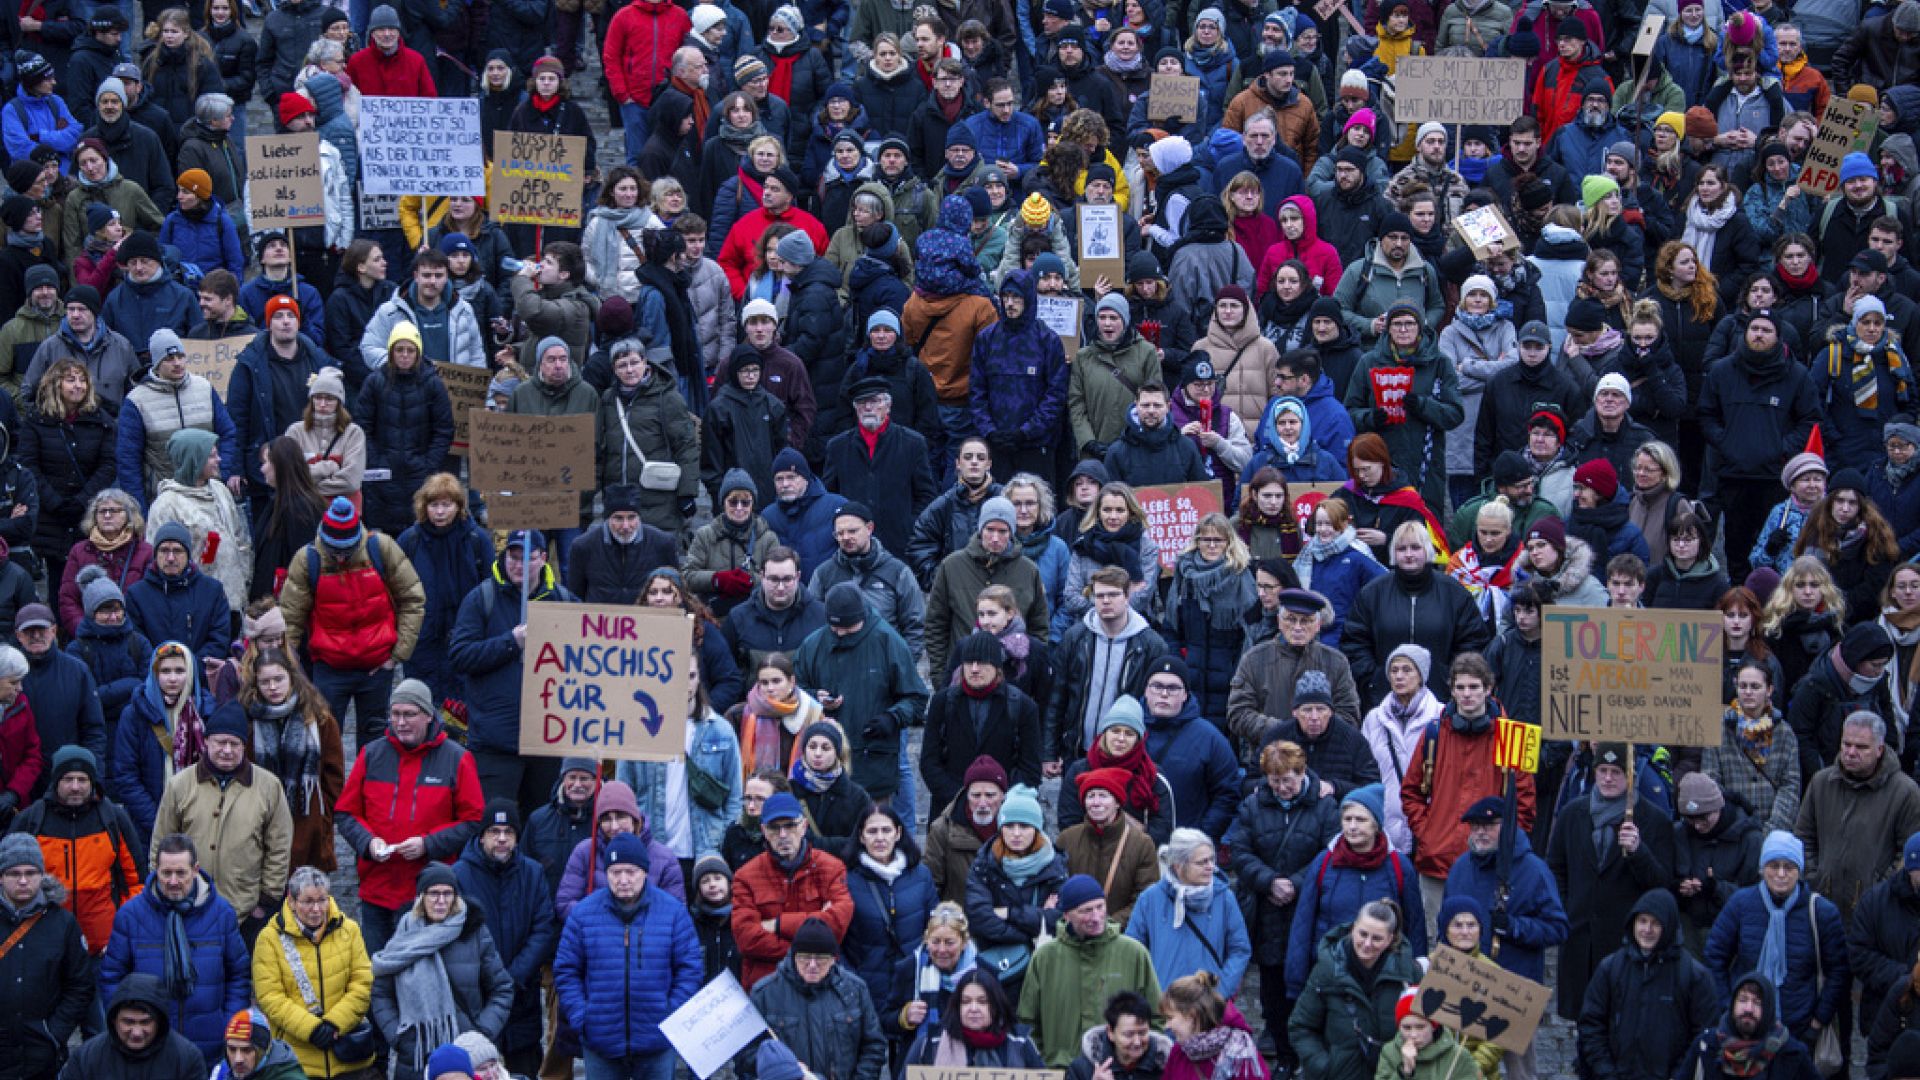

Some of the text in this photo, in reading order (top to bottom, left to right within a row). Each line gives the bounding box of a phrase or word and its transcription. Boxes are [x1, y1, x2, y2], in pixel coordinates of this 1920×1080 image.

[1443, 60, 1473, 79] MIT
[1480, 60, 1520, 81] NAZIS
[1432, 80, 1504, 97] SPAZIERT
[380, 99, 432, 114] PROTEST
[438, 101, 453, 115] DIE
[1398, 98, 1424, 117] HAT
[1428, 99, 1477, 120] NICHTS
[262, 143, 302, 158] Lieber
[512, 146, 568, 163] OUT OF
[521, 179, 550, 192] AFD
[1798, 166, 1839, 192] AFD
[275, 185, 296, 200] als
[510, 190, 564, 207] OUT OF
[1142, 499, 1170, 514] LEBE
[1147, 510, 1198, 526] DASS DIE
[1151, 525, 1165, 538] FD
[581, 613, 638, 641] NUR
[1545, 614, 1721, 664] TOLERANZ
[534, 641, 675, 685] ANSCHISS
[1551, 664, 1570, 681] ist
[1669, 667, 1693, 679] MAN
[1670, 683, 1703, 695] KANN
[1607, 694, 1692, 709] GENUG DAVON
[1550, 694, 1603, 735] NIE!
[543, 713, 625, 746] DICH
[1610, 714, 1659, 737] HABEN
[1492, 720, 1526, 768] NO
